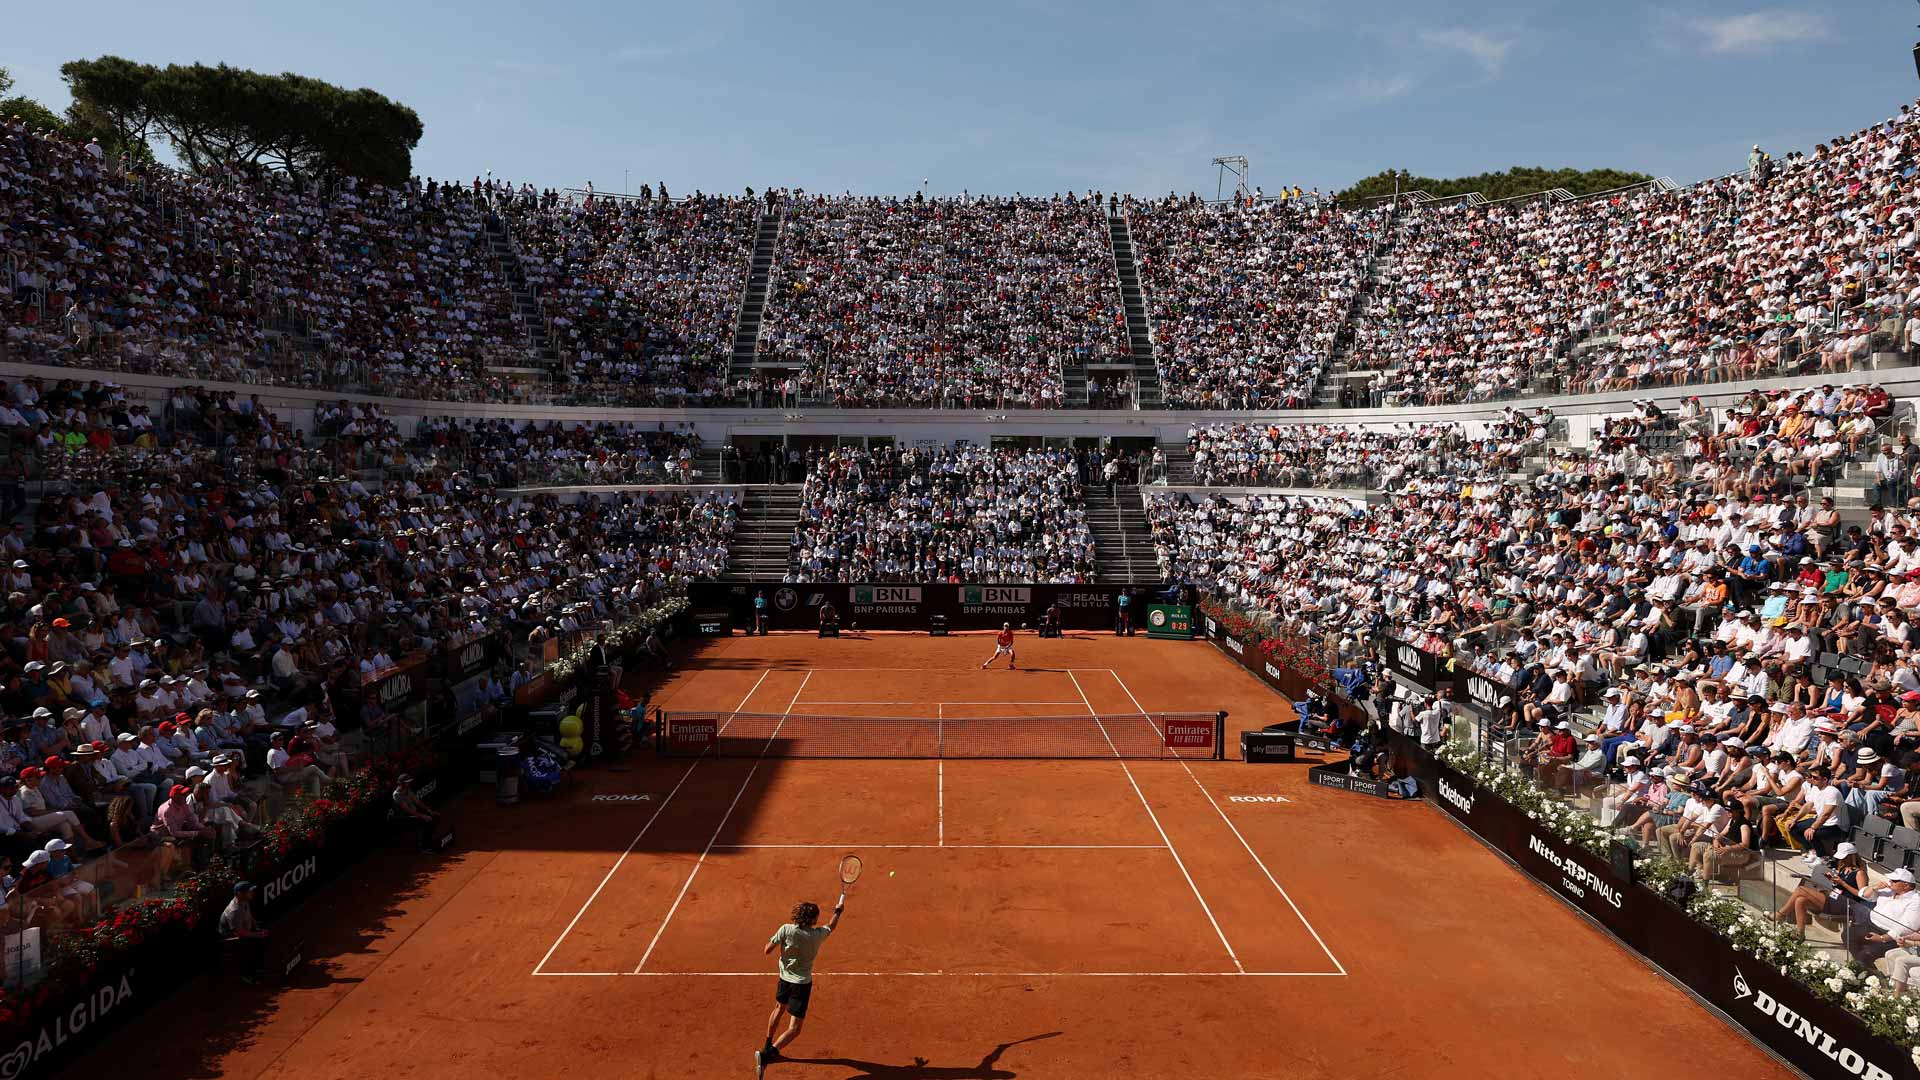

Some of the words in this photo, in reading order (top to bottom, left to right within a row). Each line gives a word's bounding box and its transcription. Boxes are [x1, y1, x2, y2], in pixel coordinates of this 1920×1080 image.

[877, 589, 917, 600] BNL
[986, 589, 1025, 601] BNL
[1073, 593, 1110, 601] REALE
[876, 606, 917, 614] PARIBAS
[963, 606, 984, 614] BNP
[985, 606, 1026, 614] PARIBAS
[1397, 646, 1421, 671] VALMORA
[1265, 662, 1280, 679] RICOH
[379, 674, 412, 704] VALMORA
[1467, 677, 1500, 708] VALMORA
[672, 724, 715, 734] Emirates
[1168, 725, 1210, 735] Emirates
[1252, 744, 1265, 754] sky
[1323, 775, 1345, 784] SPORT
[1354, 781, 1377, 790] SPORT
[1438, 777, 1471, 814] ticketone
[1529, 834, 1562, 867] Nitto
[1561, 858, 1587, 881] ATP
[1586, 872, 1622, 908] FINALS
[263, 855, 316, 907] RICOH
[1562, 877, 1585, 898] TORINO
[32, 974, 134, 1062] ALGIDA
